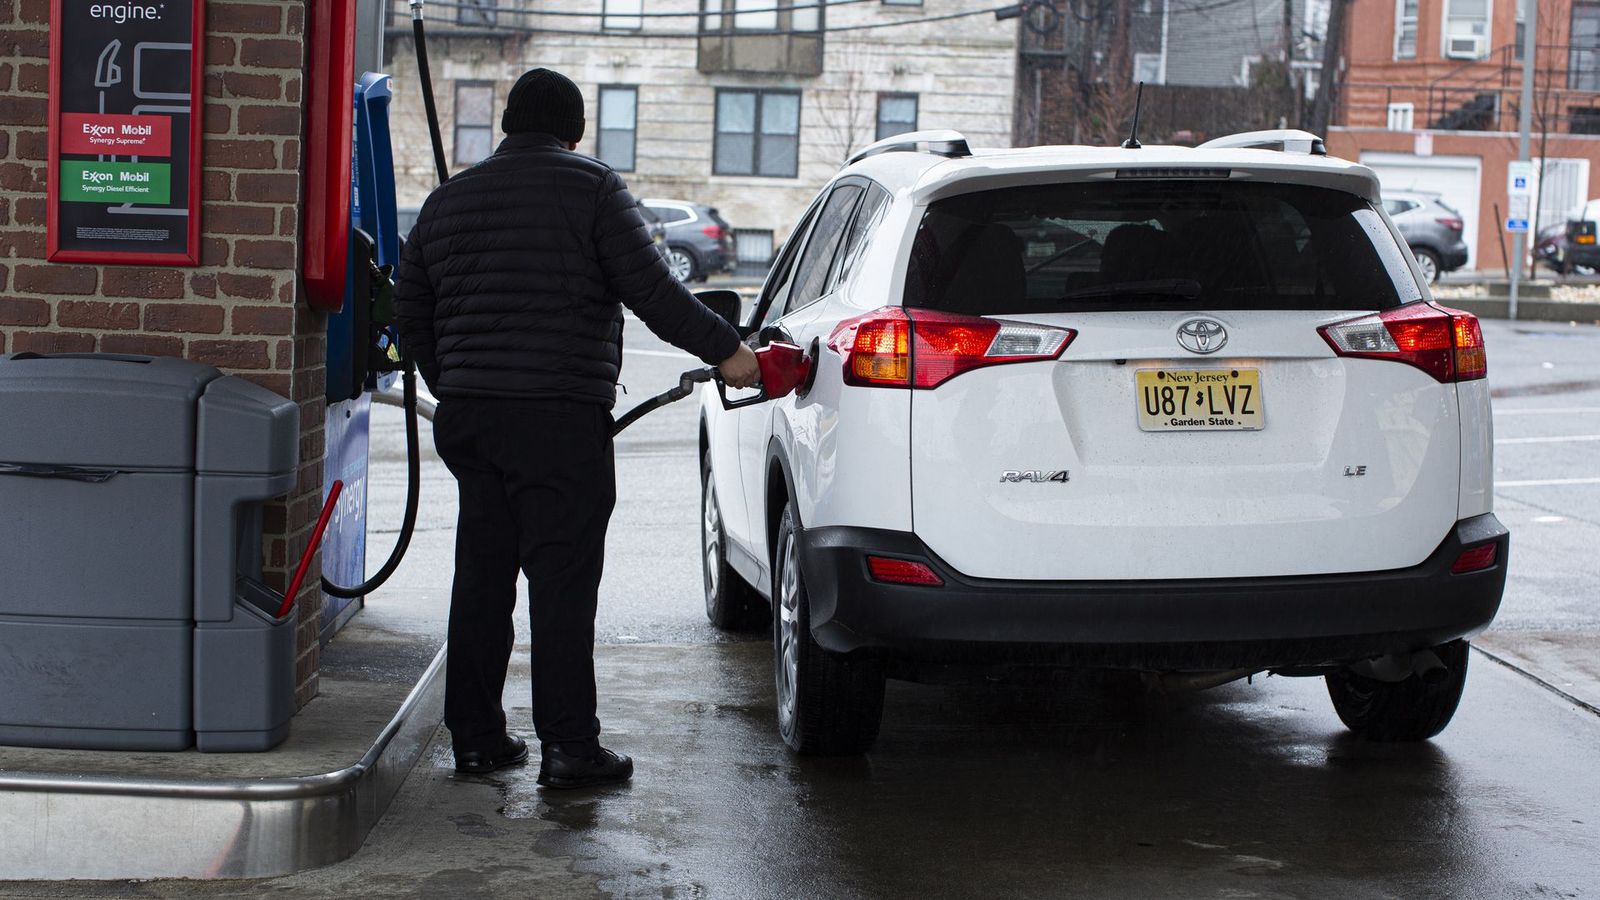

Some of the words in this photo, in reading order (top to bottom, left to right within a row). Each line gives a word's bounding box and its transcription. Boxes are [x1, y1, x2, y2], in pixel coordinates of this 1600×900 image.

[82, 123, 115, 137] Exxon
[121, 125, 152, 135] Mobil
[89, 137, 115, 145] Synergy
[82, 170, 113, 184] Exxon
[120, 172, 150, 182] Mobil
[82, 184, 105, 192] Synergy
[1166, 372, 1193, 382] New
[1195, 372, 1230, 384] Jersey
[1144, 385, 1190, 416] U87
[1207, 384, 1255, 415] LVZ
[1170, 417, 1205, 427] Garden
[1208, 417, 1234, 426] State
[999, 470, 1070, 483] RAV4
[1343, 465, 1367, 477] LE
